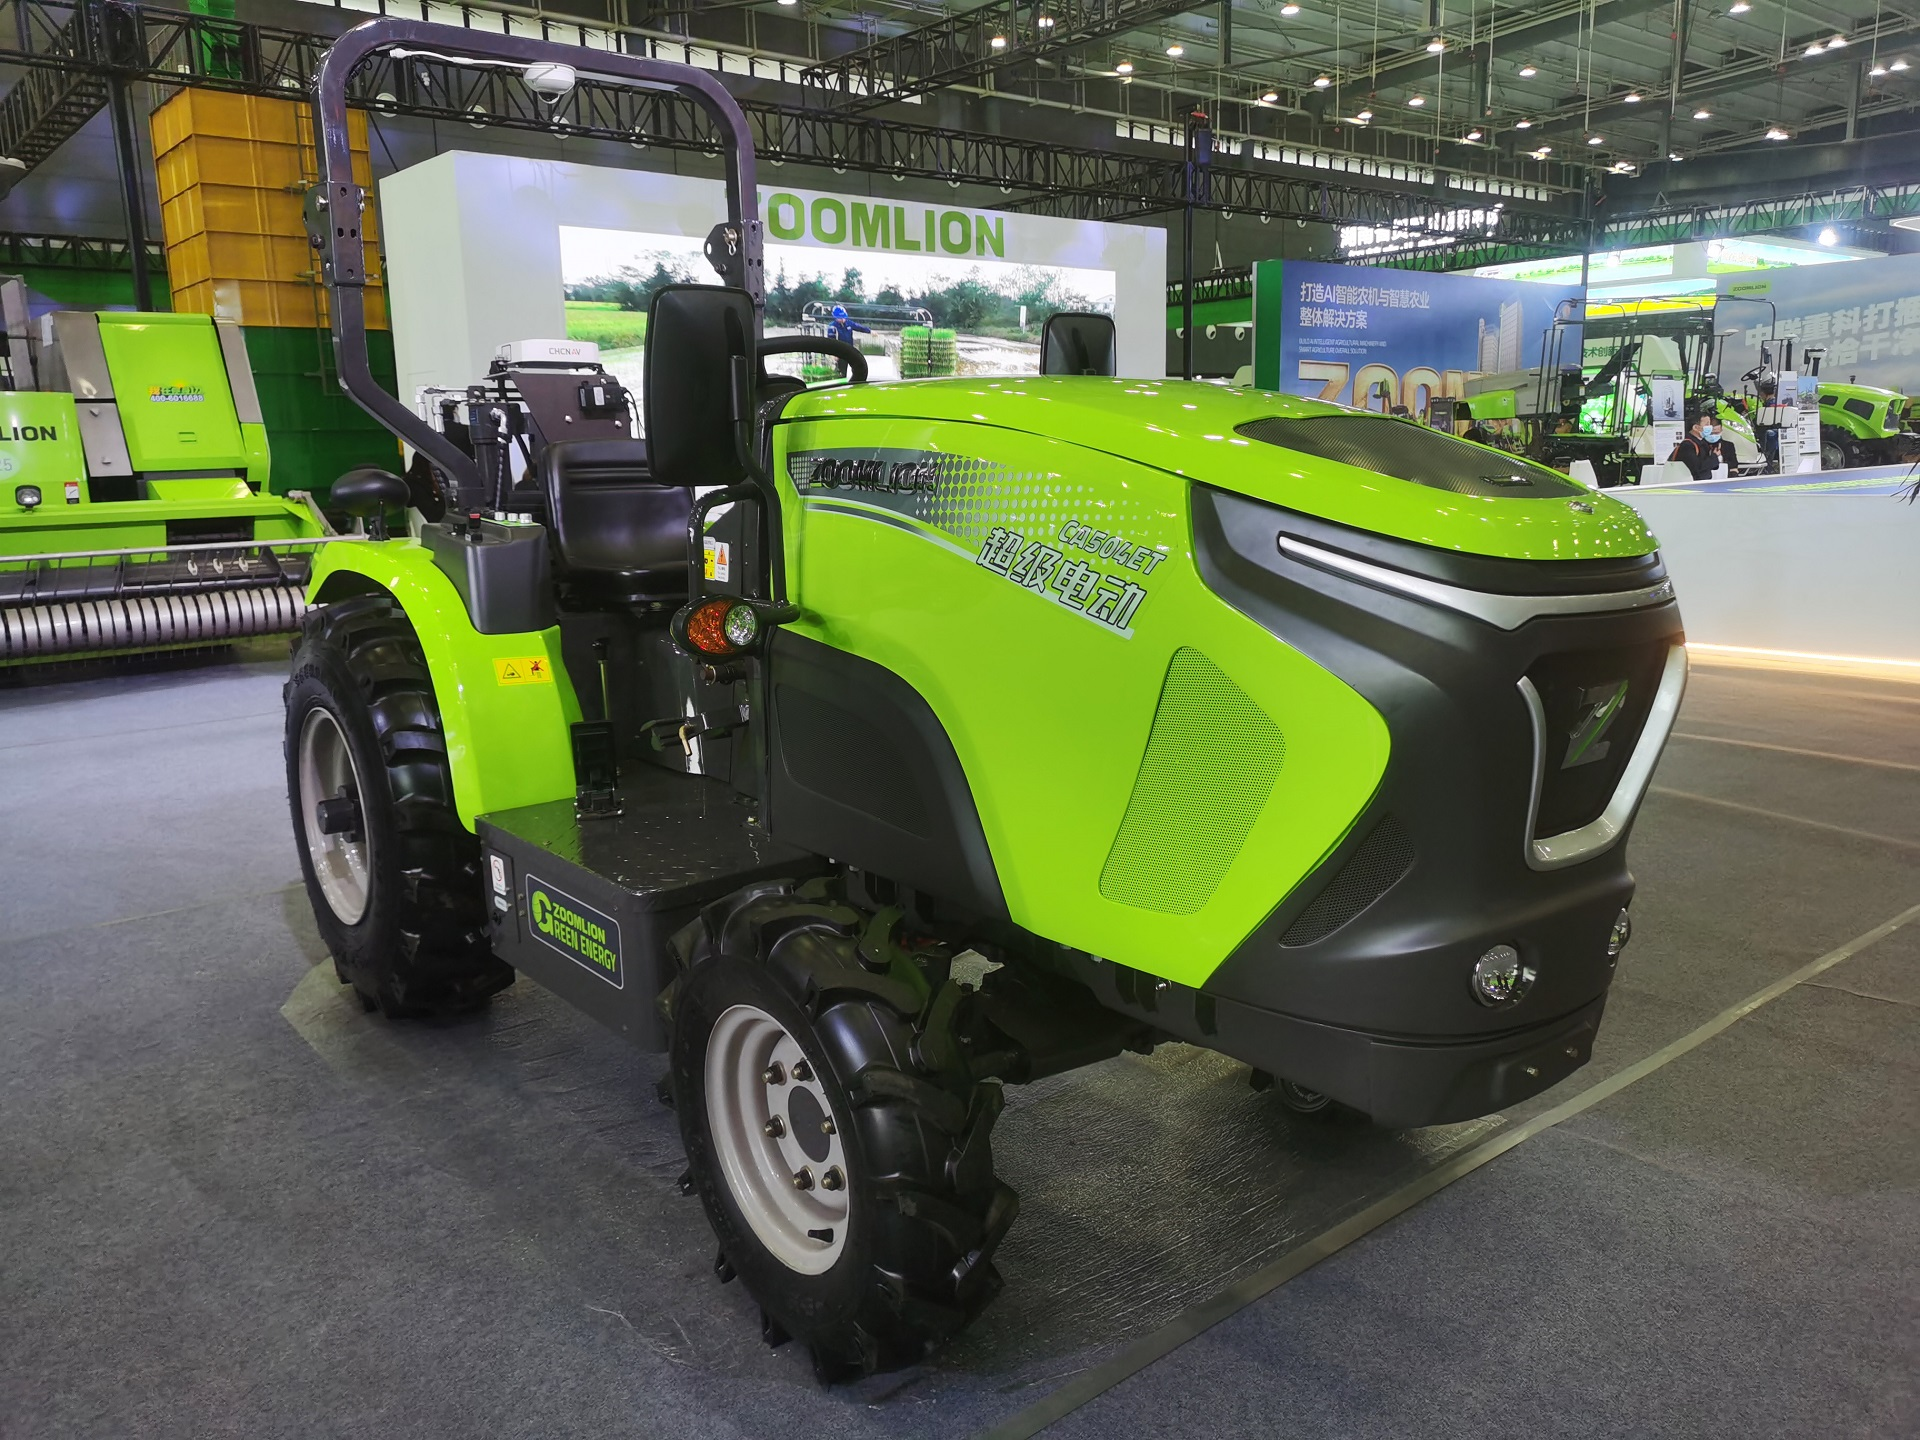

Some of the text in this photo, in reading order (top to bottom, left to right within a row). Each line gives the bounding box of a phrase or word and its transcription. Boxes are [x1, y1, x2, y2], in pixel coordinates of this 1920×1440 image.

[757, 193, 1005, 258] OOMLION
[1300, 281, 1430, 309] 打造AI智能农机与智慧农业
[1299, 306, 1368, 329] 整体解决方案
[548, 347, 581, 355] CHCNAV
[1057, 518, 1168, 578] CA504ET
[975, 526, 1148, 631] 超级电动
[552, 902, 607, 945] ZOOMLION
[580, 935, 617, 973] ENERGY
